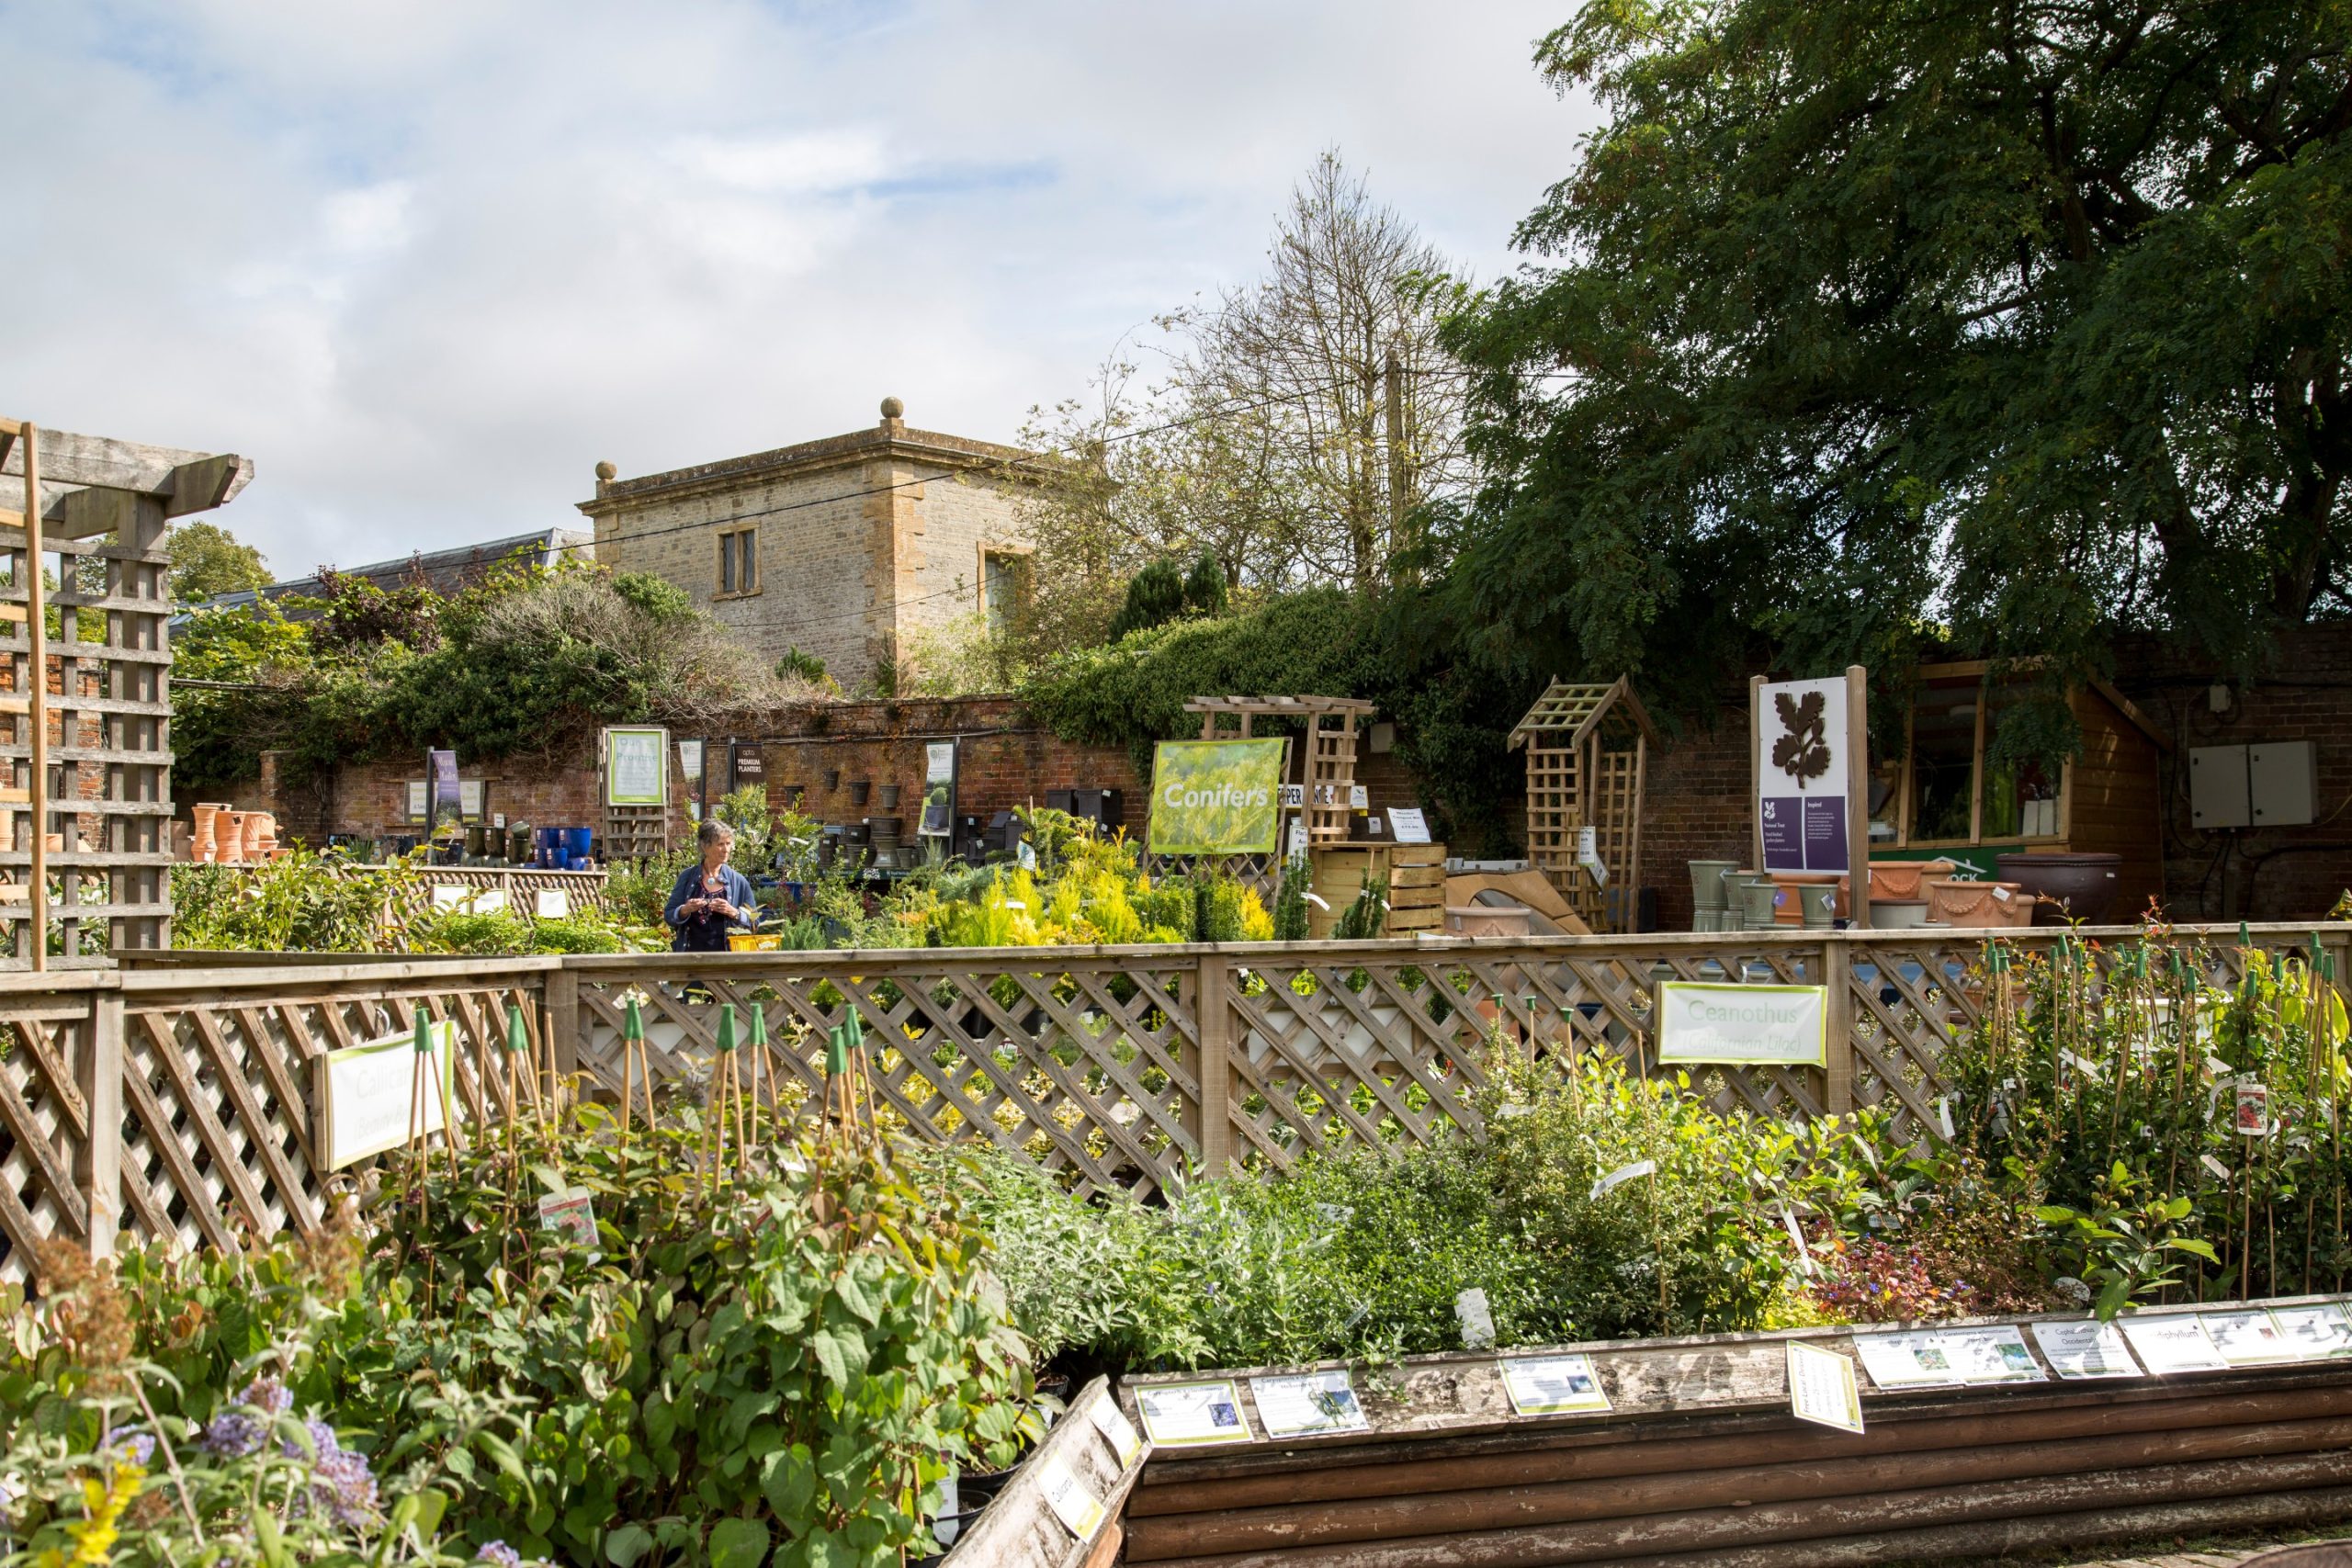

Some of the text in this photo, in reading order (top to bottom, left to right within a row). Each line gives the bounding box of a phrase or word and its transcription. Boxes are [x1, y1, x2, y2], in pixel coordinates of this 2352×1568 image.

[616, 752, 658, 762] Promise
[738, 765, 762, 773] PLANTERS
[1164, 783, 1269, 808] Conifers
[1689, 999, 1799, 1024] Ceanothus
[1683, 1034, 1802, 1055] (Californian Lilac)
[356, 1065, 413, 1100] Callicar
